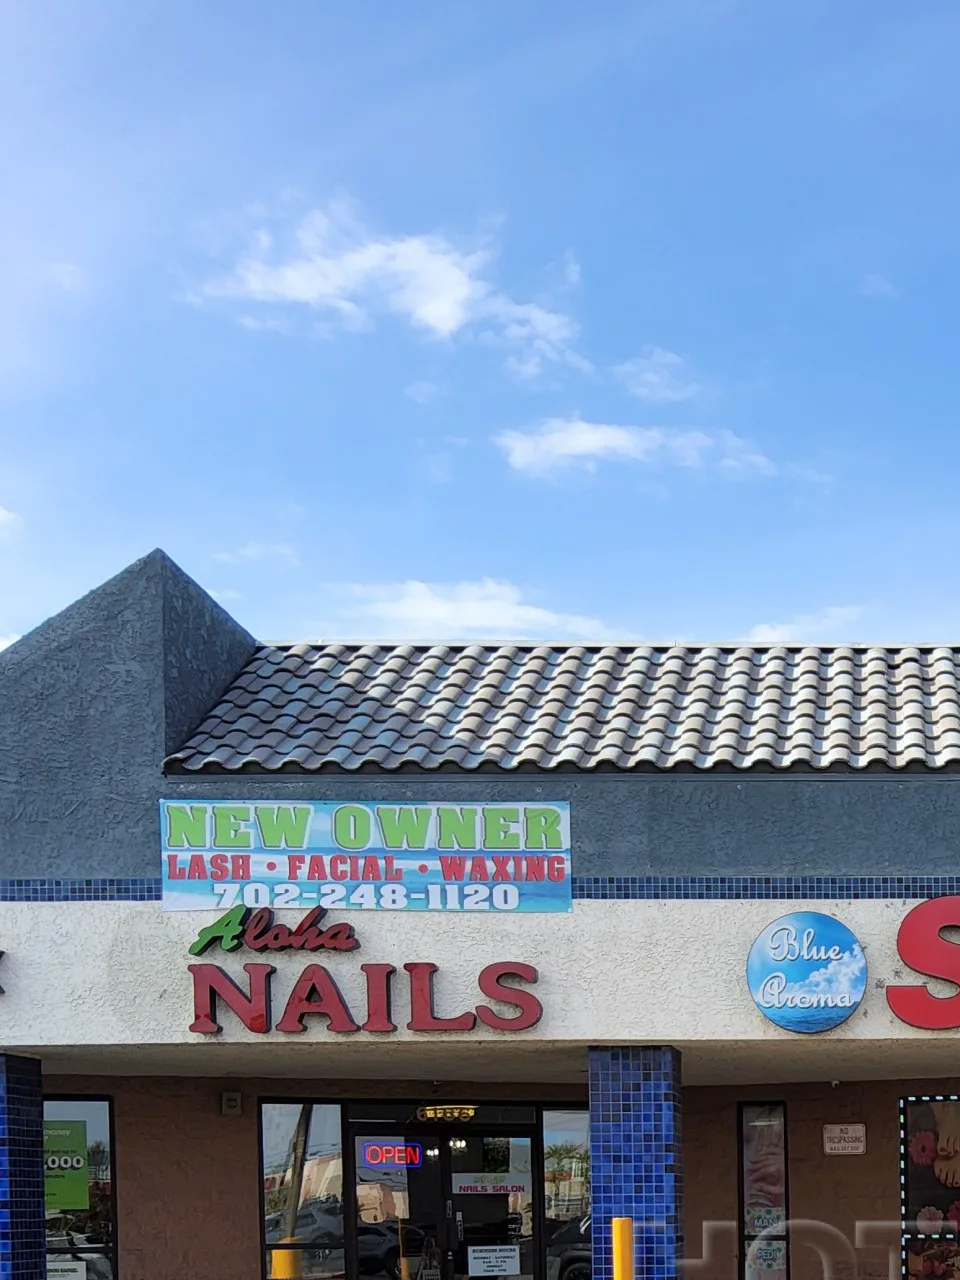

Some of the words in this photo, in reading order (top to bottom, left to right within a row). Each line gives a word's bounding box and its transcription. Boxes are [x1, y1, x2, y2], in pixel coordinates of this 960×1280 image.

[166, 804, 313, 849] NEW
[334, 804, 564, 850] OWNER
[168, 854, 251, 881] LASH
[288, 854, 403, 881] FACIAL
[439, 854, 566, 882] WAXING
[213, 883, 519, 909] 702-248-1120
[189, 904, 361, 956] Aloha
[769, 925, 844, 963] Blue
[188, 961, 544, 1034] NAILS
[760, 972, 854, 1010] Aroma
[366, 1145, 420, 1164] OPEN
[458, 1185, 488, 1193] NAILS
[492, 1185, 525, 1193] SALON
[756, 1249, 778, 1260] PEDI
